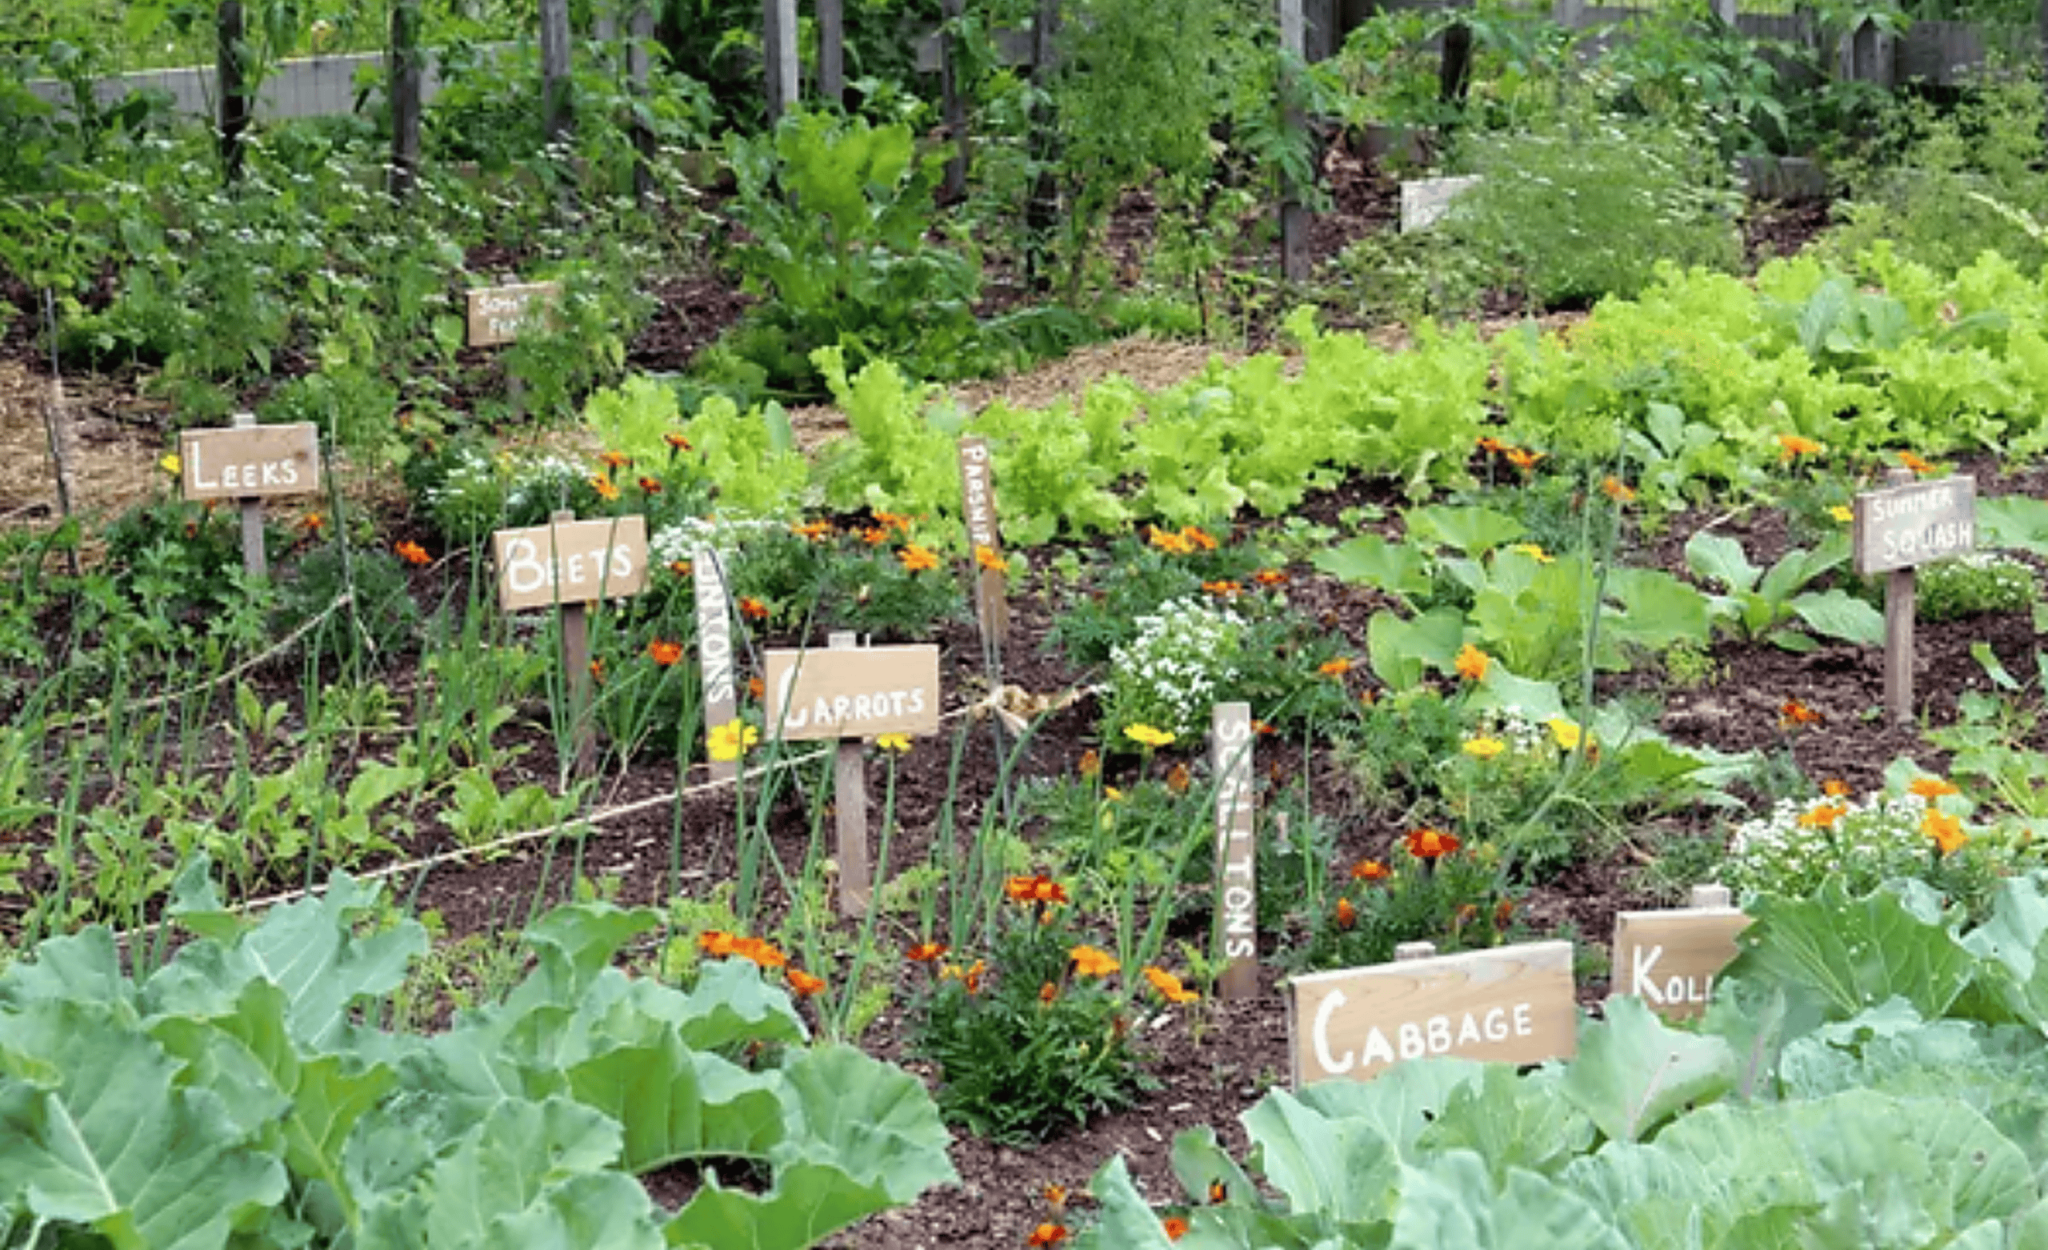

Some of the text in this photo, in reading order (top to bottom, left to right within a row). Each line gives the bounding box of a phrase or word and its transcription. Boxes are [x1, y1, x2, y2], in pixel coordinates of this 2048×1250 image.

[192, 440, 298, 489] LEEKS
[506, 537, 632, 593] BEETS
[1883, 521, 1973, 561] SQUASH
[778, 664, 925, 728] CARROTS
[1312, 988, 1533, 1074] CABBAGE
